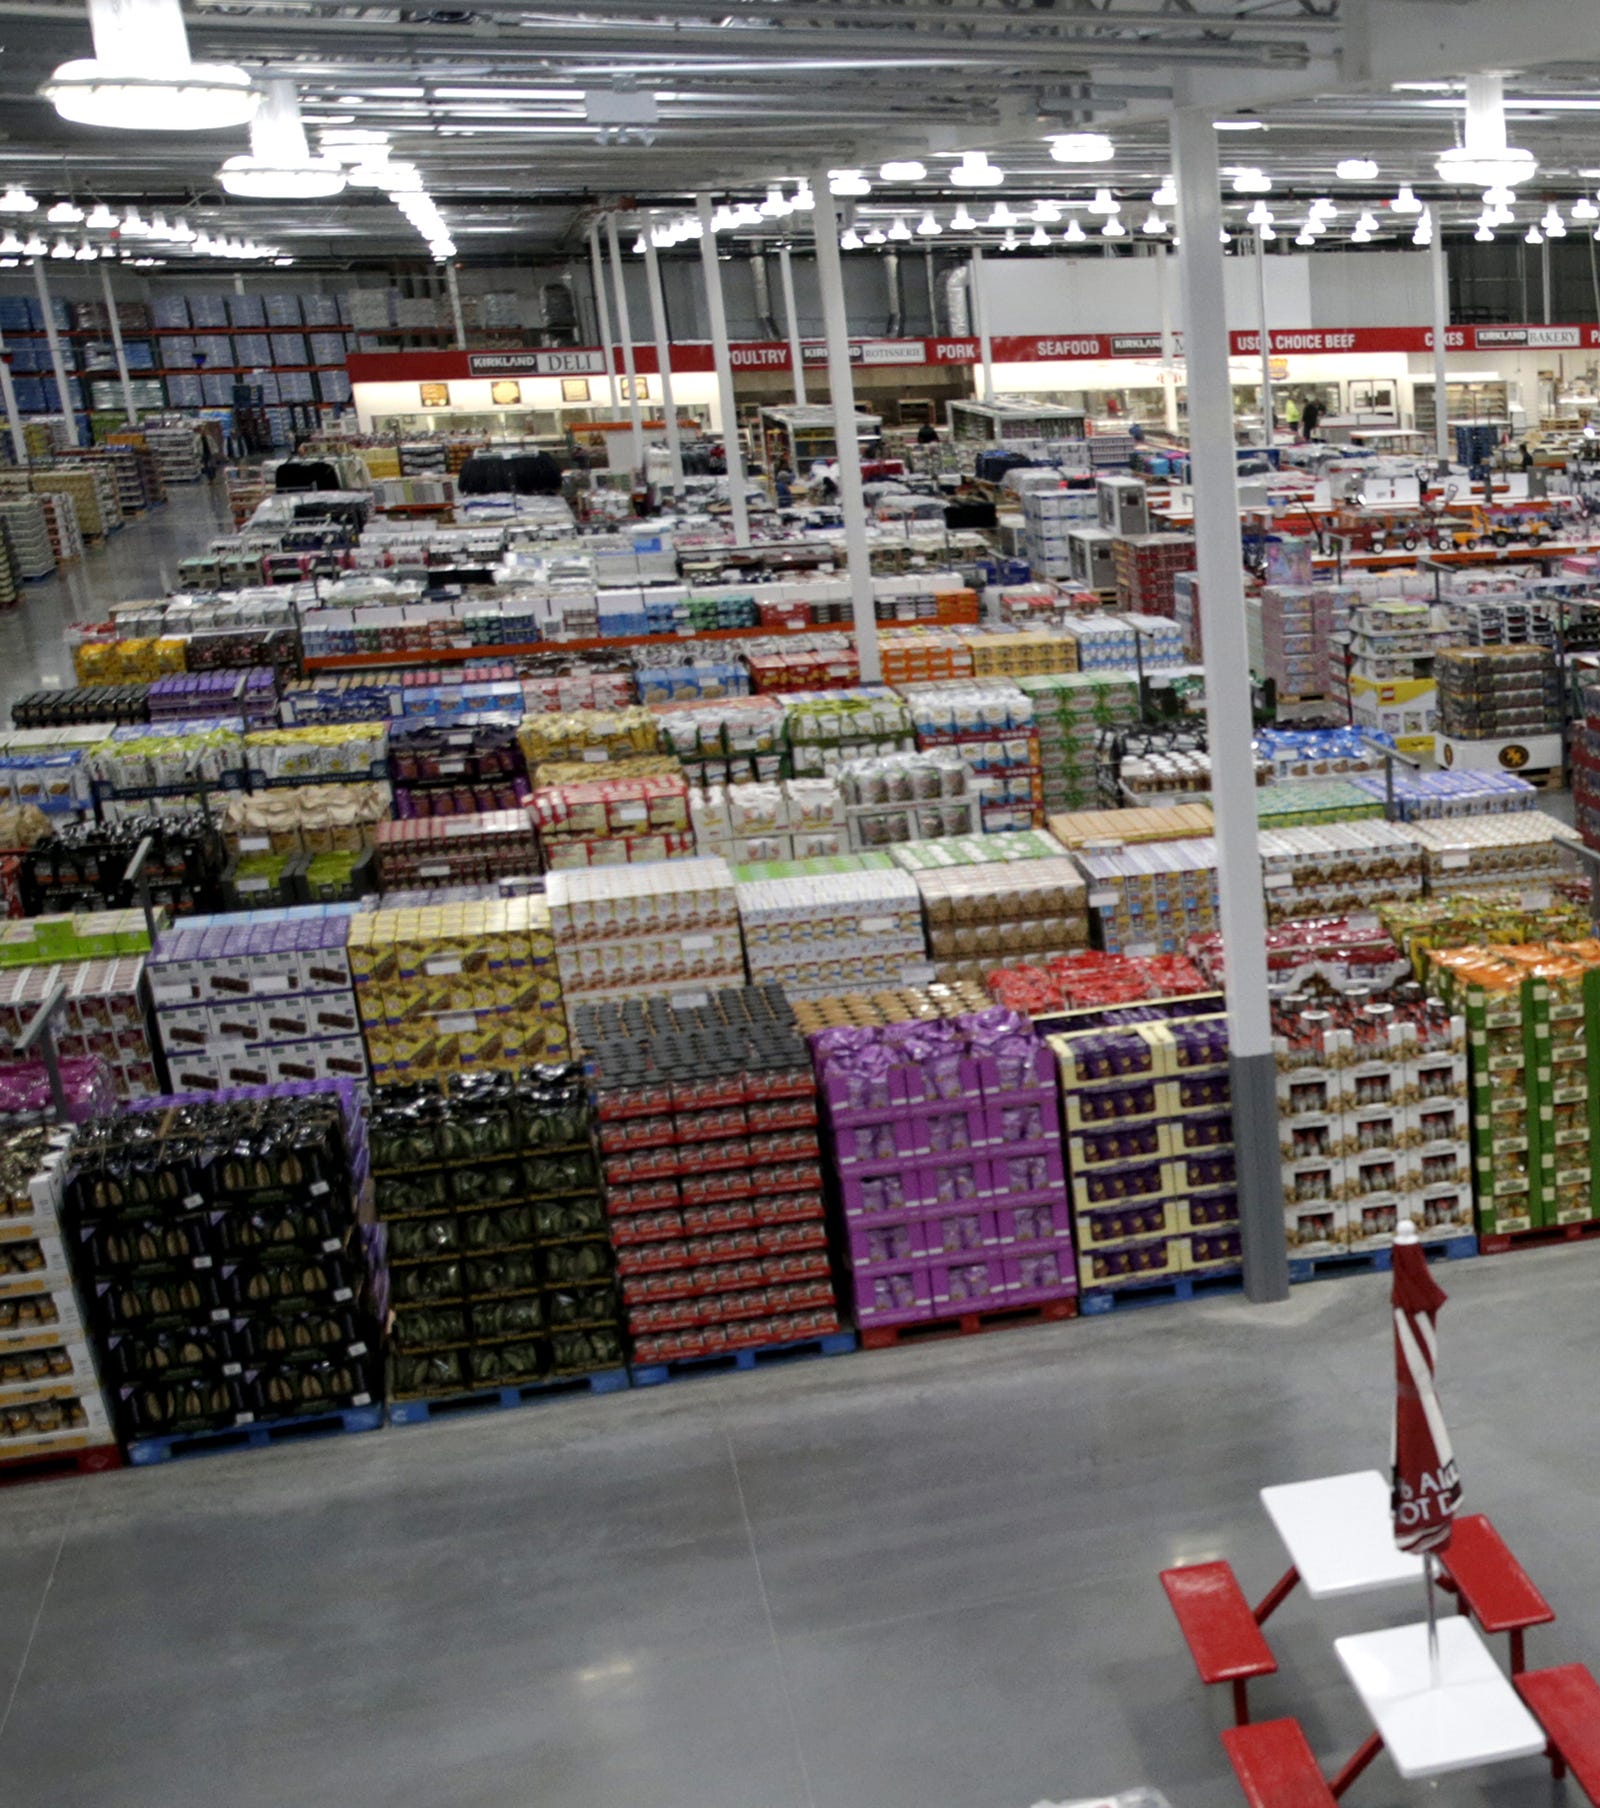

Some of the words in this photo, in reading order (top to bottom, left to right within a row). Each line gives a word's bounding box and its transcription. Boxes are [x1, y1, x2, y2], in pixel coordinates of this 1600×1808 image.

[1114, 337, 1164, 350] KIRKLAN
[1275, 334, 1322, 350] CHOICE
[1325, 333, 1356, 348] BEEF
[1424, 332, 1465, 347] CKES
[1478, 330, 1527, 342] KIRKLAND
[1529, 328, 1578, 344] BAKERY
[936, 343, 976, 359] PORK
[1037, 340, 1100, 356] SEAFOOD
[473, 354, 535, 368] KIRKLAND
[549, 354, 592, 372] DELI
[729, 349, 787, 366] OULTRY
